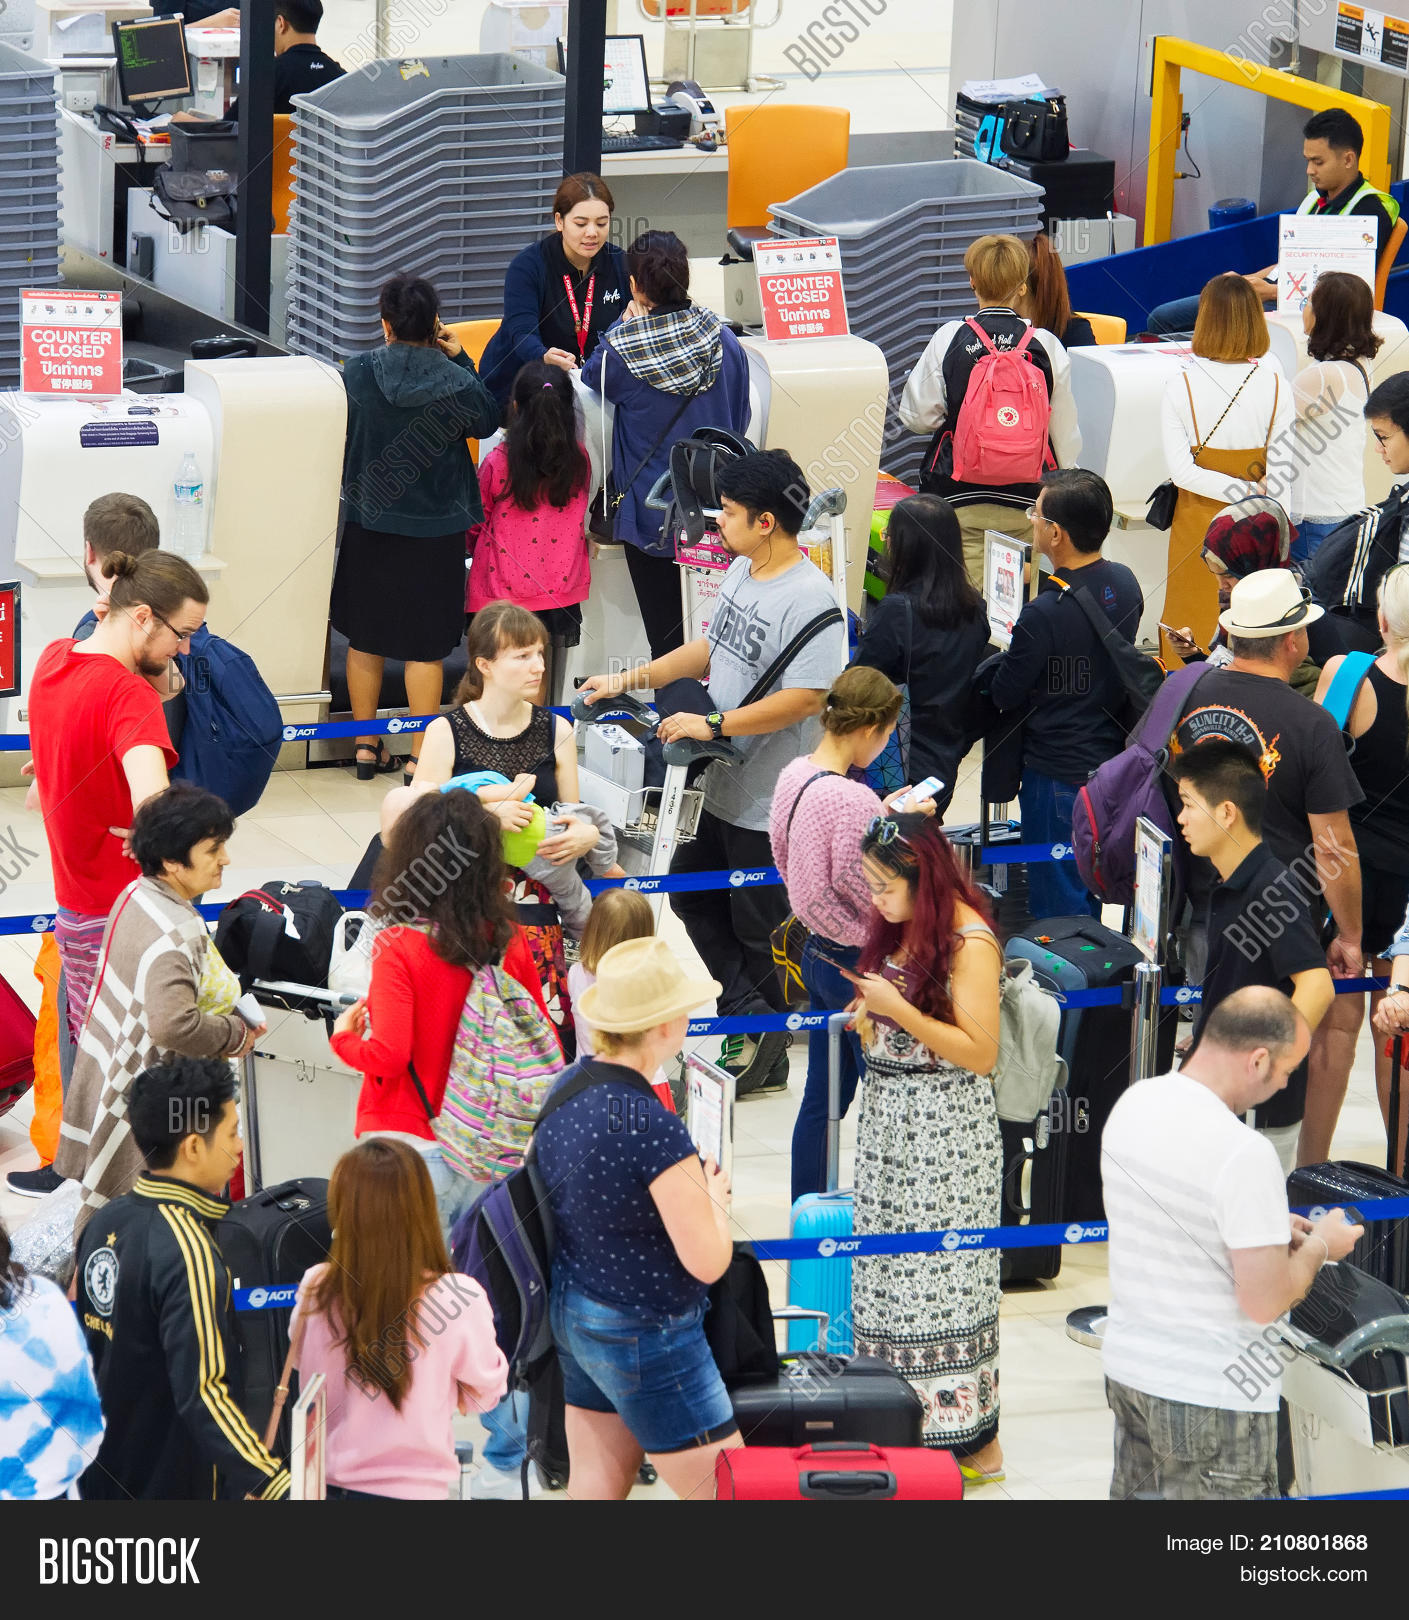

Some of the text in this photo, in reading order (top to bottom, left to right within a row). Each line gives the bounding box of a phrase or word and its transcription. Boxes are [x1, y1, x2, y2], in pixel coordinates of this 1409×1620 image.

[767, 276, 834, 292] COUNTER
[775, 289, 830, 305] CLOSED
[31, 329, 112, 345] COUNTER
[38, 343, 105, 358] CLOSED
[297, 728, 317, 736] AOT
[402, 720, 422, 729] AOT
[1189, 713, 1255, 744] SUNCITY H-D
[640, 873, 765, 889] AOT AOT
[689, 1016, 824, 1032] AOT AOT
[837, 1226, 1107, 1251] AOT AOT AOT
[268, 1290, 295, 1301] AOT
